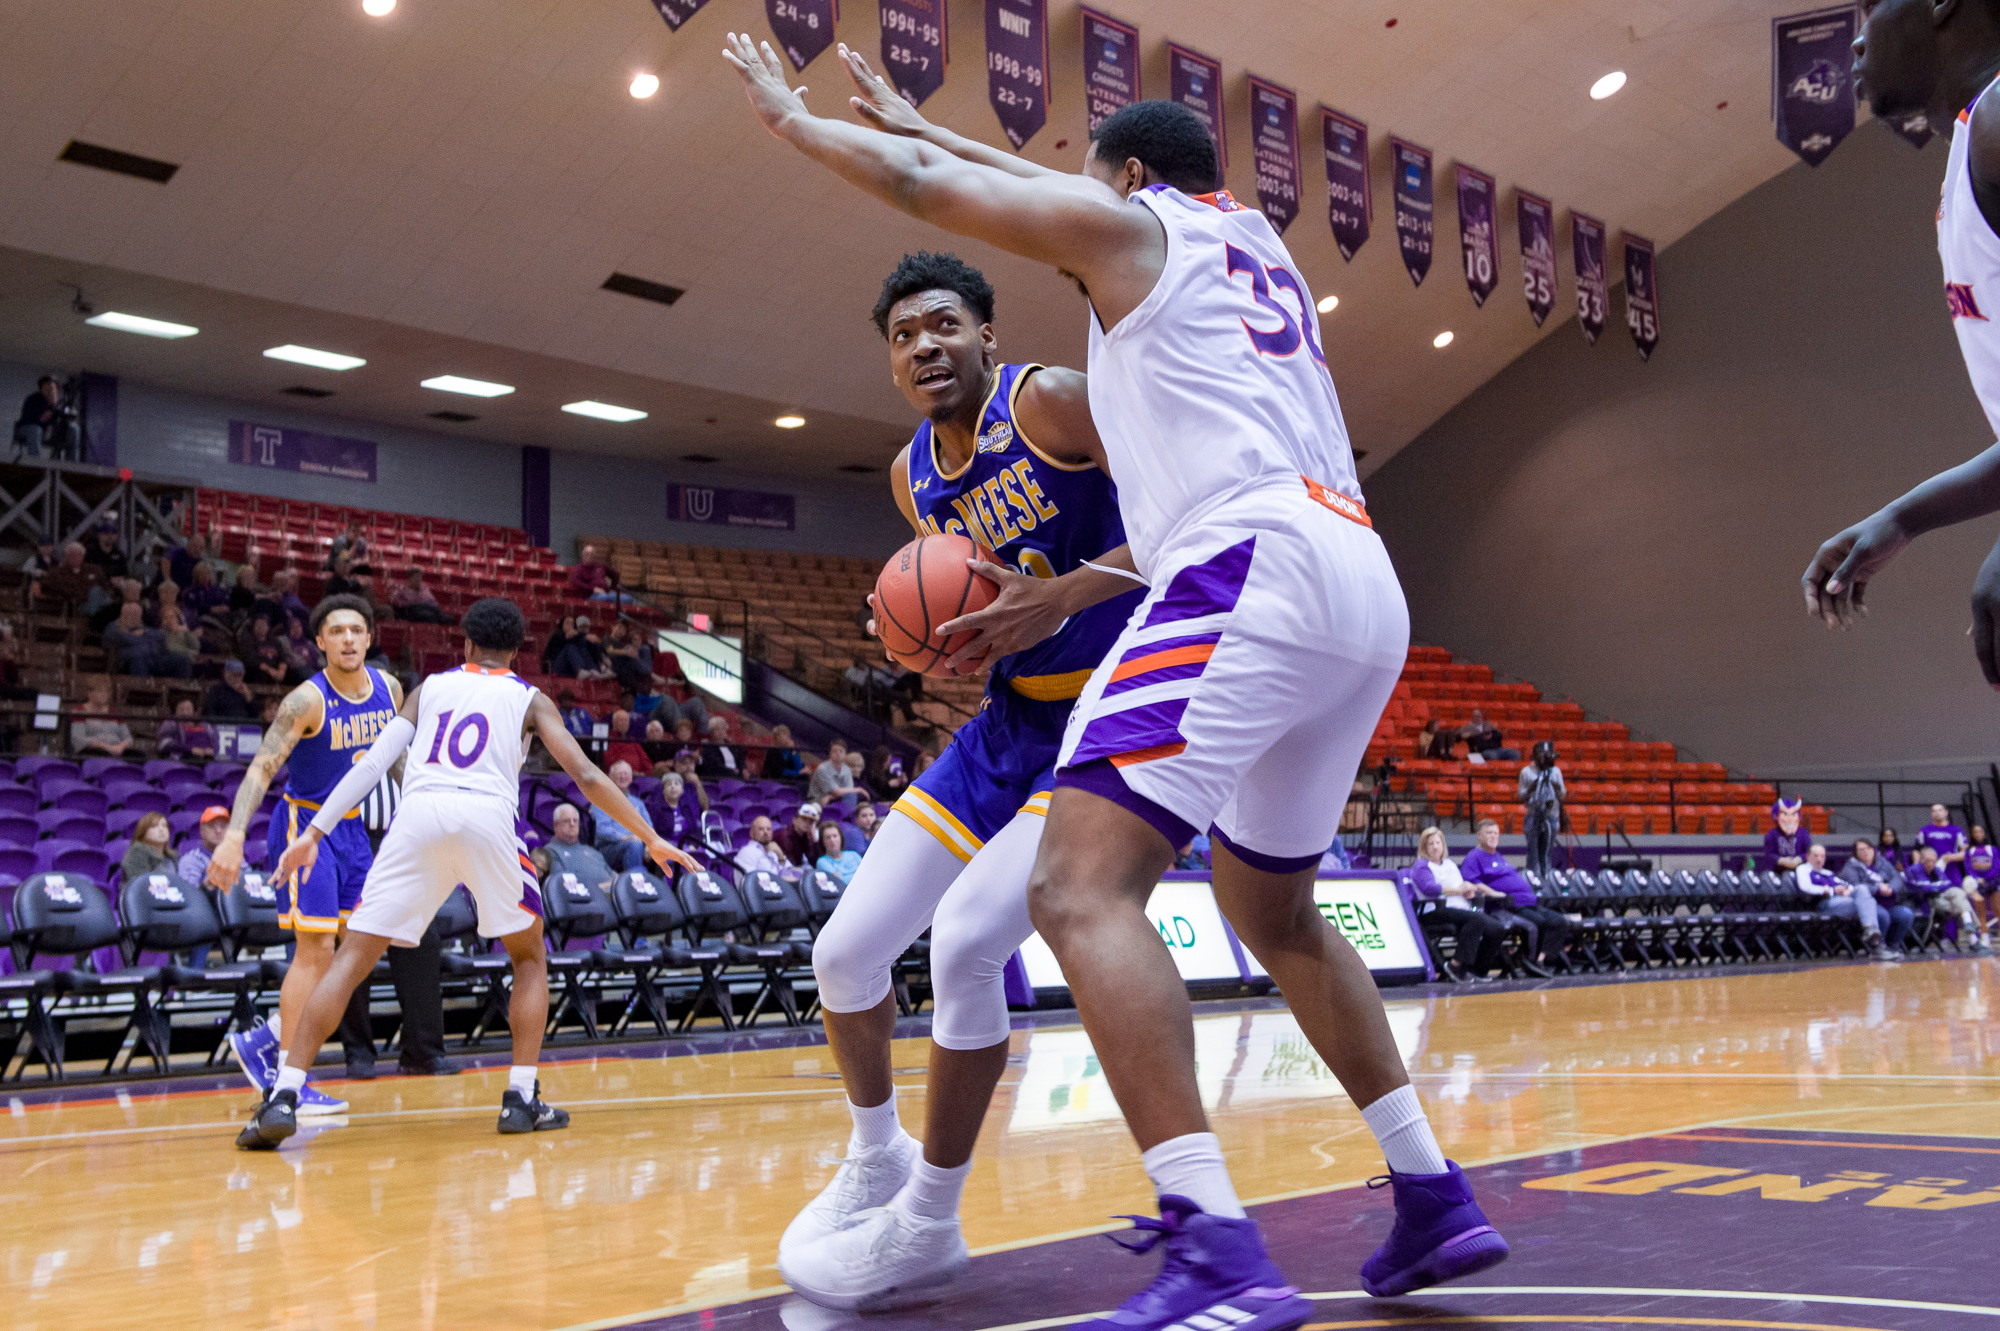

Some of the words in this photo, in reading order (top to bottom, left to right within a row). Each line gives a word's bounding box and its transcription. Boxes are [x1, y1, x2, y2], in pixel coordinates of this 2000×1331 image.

[776, 1, 819, 29] 24-8
[882, 8, 940, 46] 1994-95
[890, 44, 929, 71] 25-7
[989, 51, 1043, 87] 1998-99
[998, 87, 1033, 111] 22-7
[1794, 77, 1836, 100] ACU
[1332, 209, 1358, 229] 24-7
[1466, 250, 1491, 284] 10
[1524, 271, 1550, 304] 25
[1578, 291, 1603, 323] 33
[1629, 309, 1656, 341] 45
[254, 427, 282, 466] T
[687, 488, 714, 520] U
[1322, 488, 1362, 519] DEMONS
[218, 731, 236, 756] F
[424, 708, 490, 769] 10
